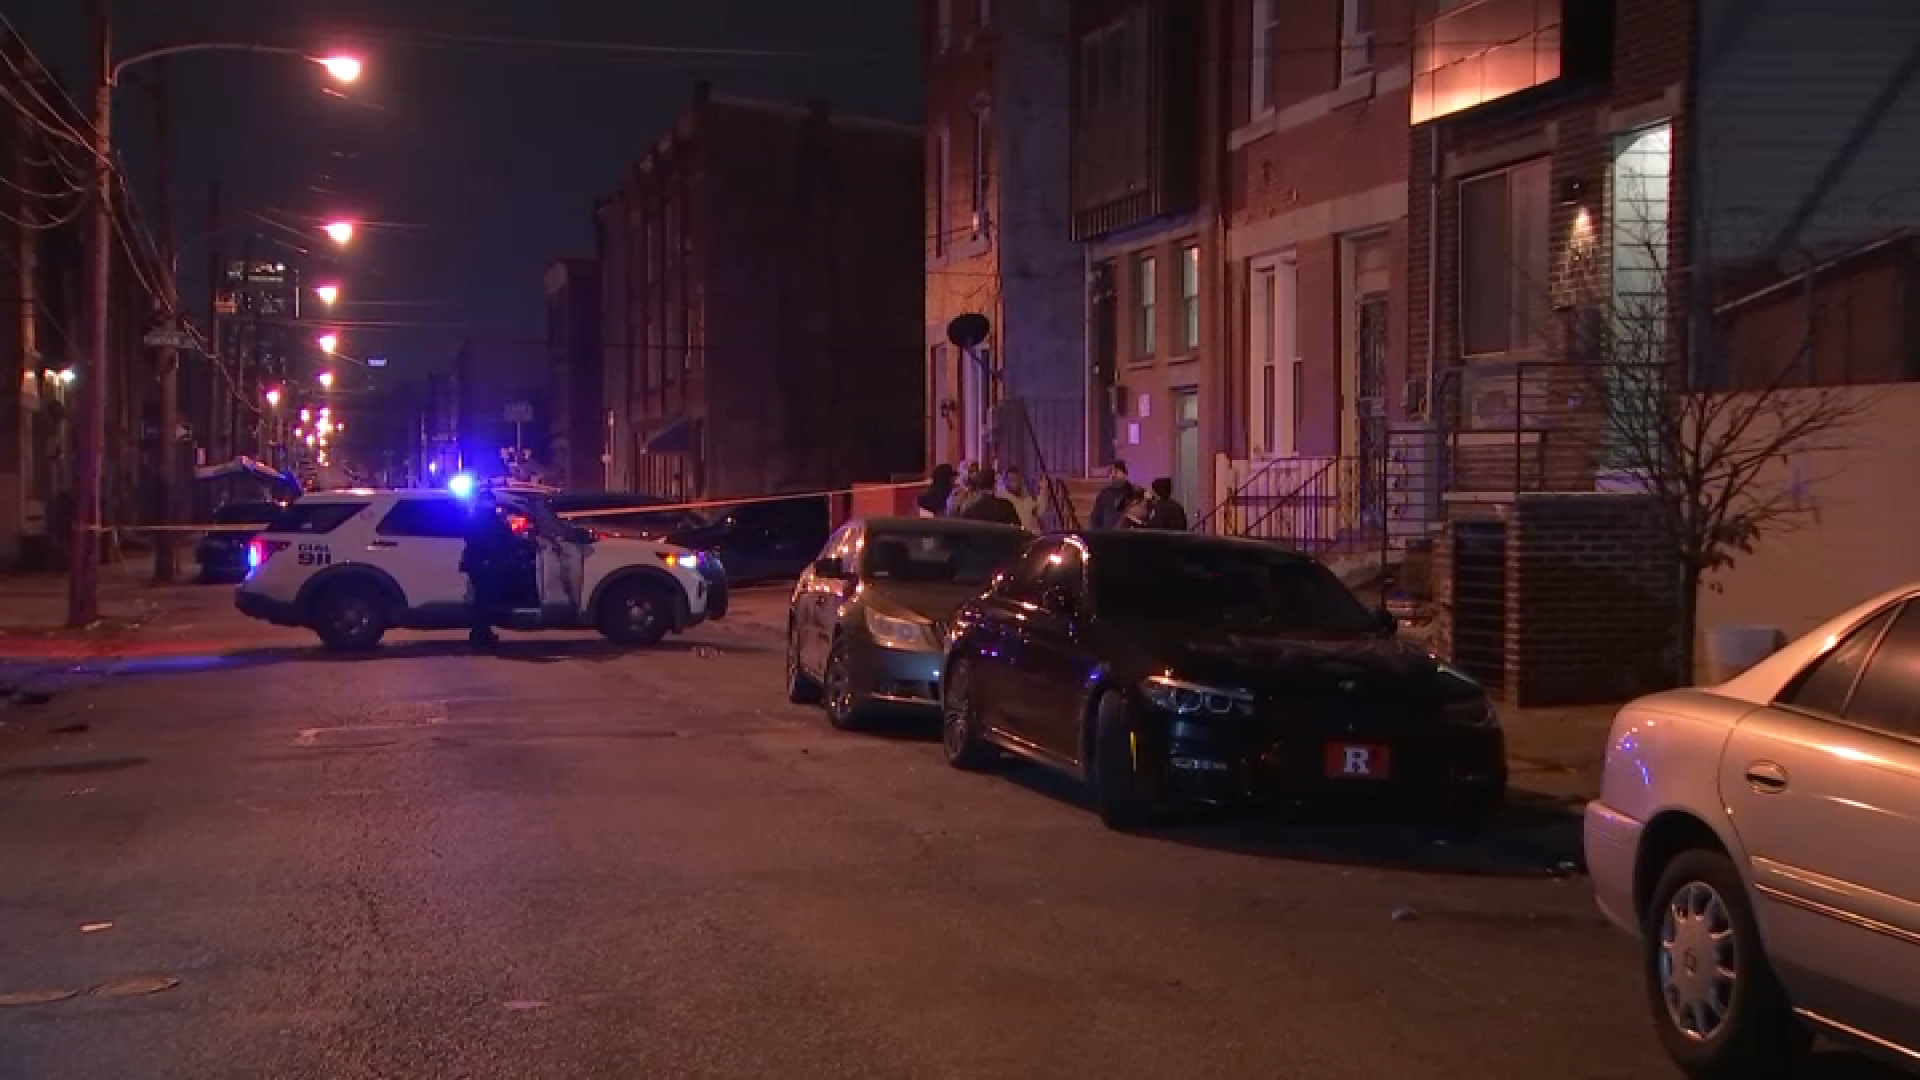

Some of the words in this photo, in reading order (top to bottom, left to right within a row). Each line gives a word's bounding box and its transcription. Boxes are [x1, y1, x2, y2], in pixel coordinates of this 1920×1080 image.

[299, 543, 329, 552] DIAL
[298, 553, 331, 566] 911
[1343, 747, 1370, 774] R
